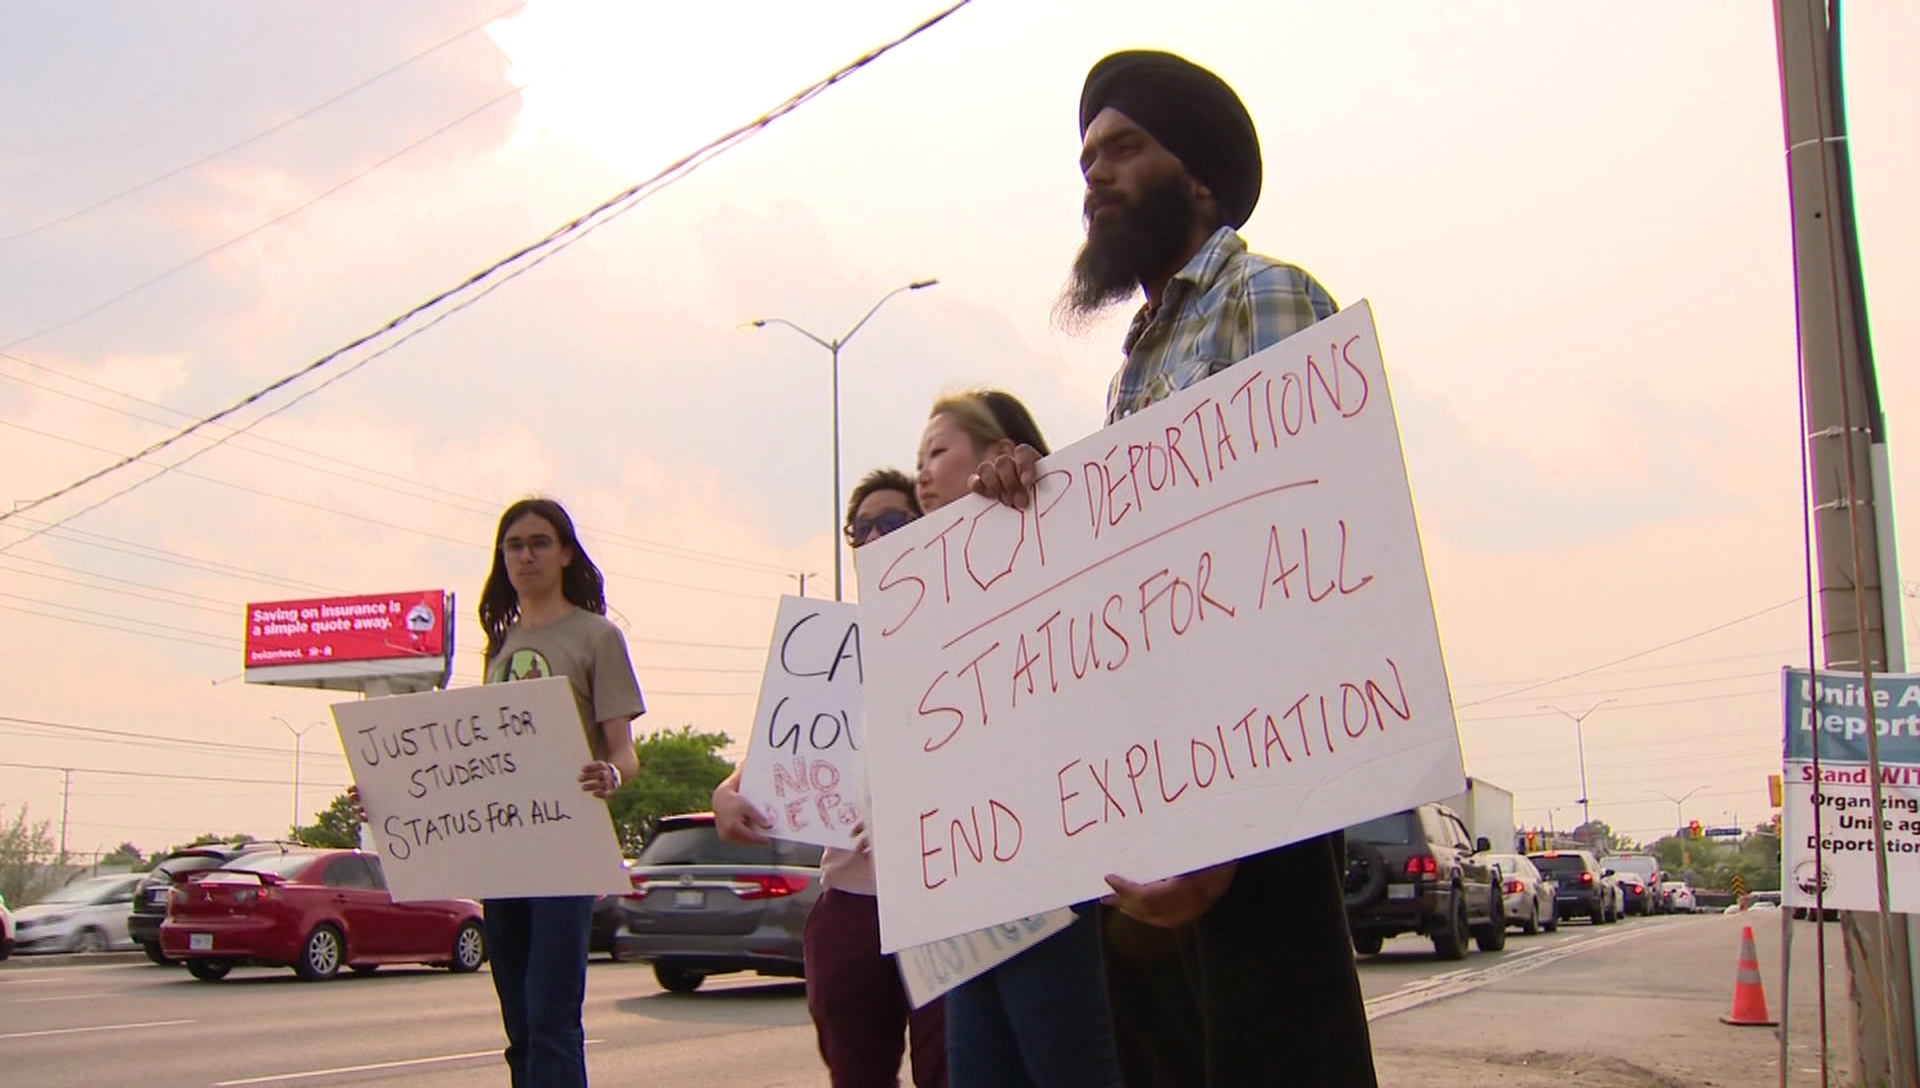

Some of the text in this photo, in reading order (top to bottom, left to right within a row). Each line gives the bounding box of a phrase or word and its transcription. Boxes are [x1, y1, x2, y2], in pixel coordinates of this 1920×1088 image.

[878, 469, 1073, 637] STOP
[252, 616, 393, 636] a simple quote away.
[253, 607, 298, 622] Saving
[301, 607, 319, 619] on
[918, 519, 1374, 752] STATUS FOR ALL
[781, 612, 863, 684] CA
[1801, 679, 1890, 708] Unite
[358, 706, 536, 767] JUSTICE FOR
[408, 752, 517, 799] STUDENTS
[773, 756, 841, 797] NO
[920, 658, 1411, 889] END EXPLOITATION
[1810, 792, 1918, 814] Organzing
[1839, 815, 1894, 830] Unie
[384, 799, 572, 860] STATUS FOR ALL
[1807, 835, 1920, 854] Deporttio
